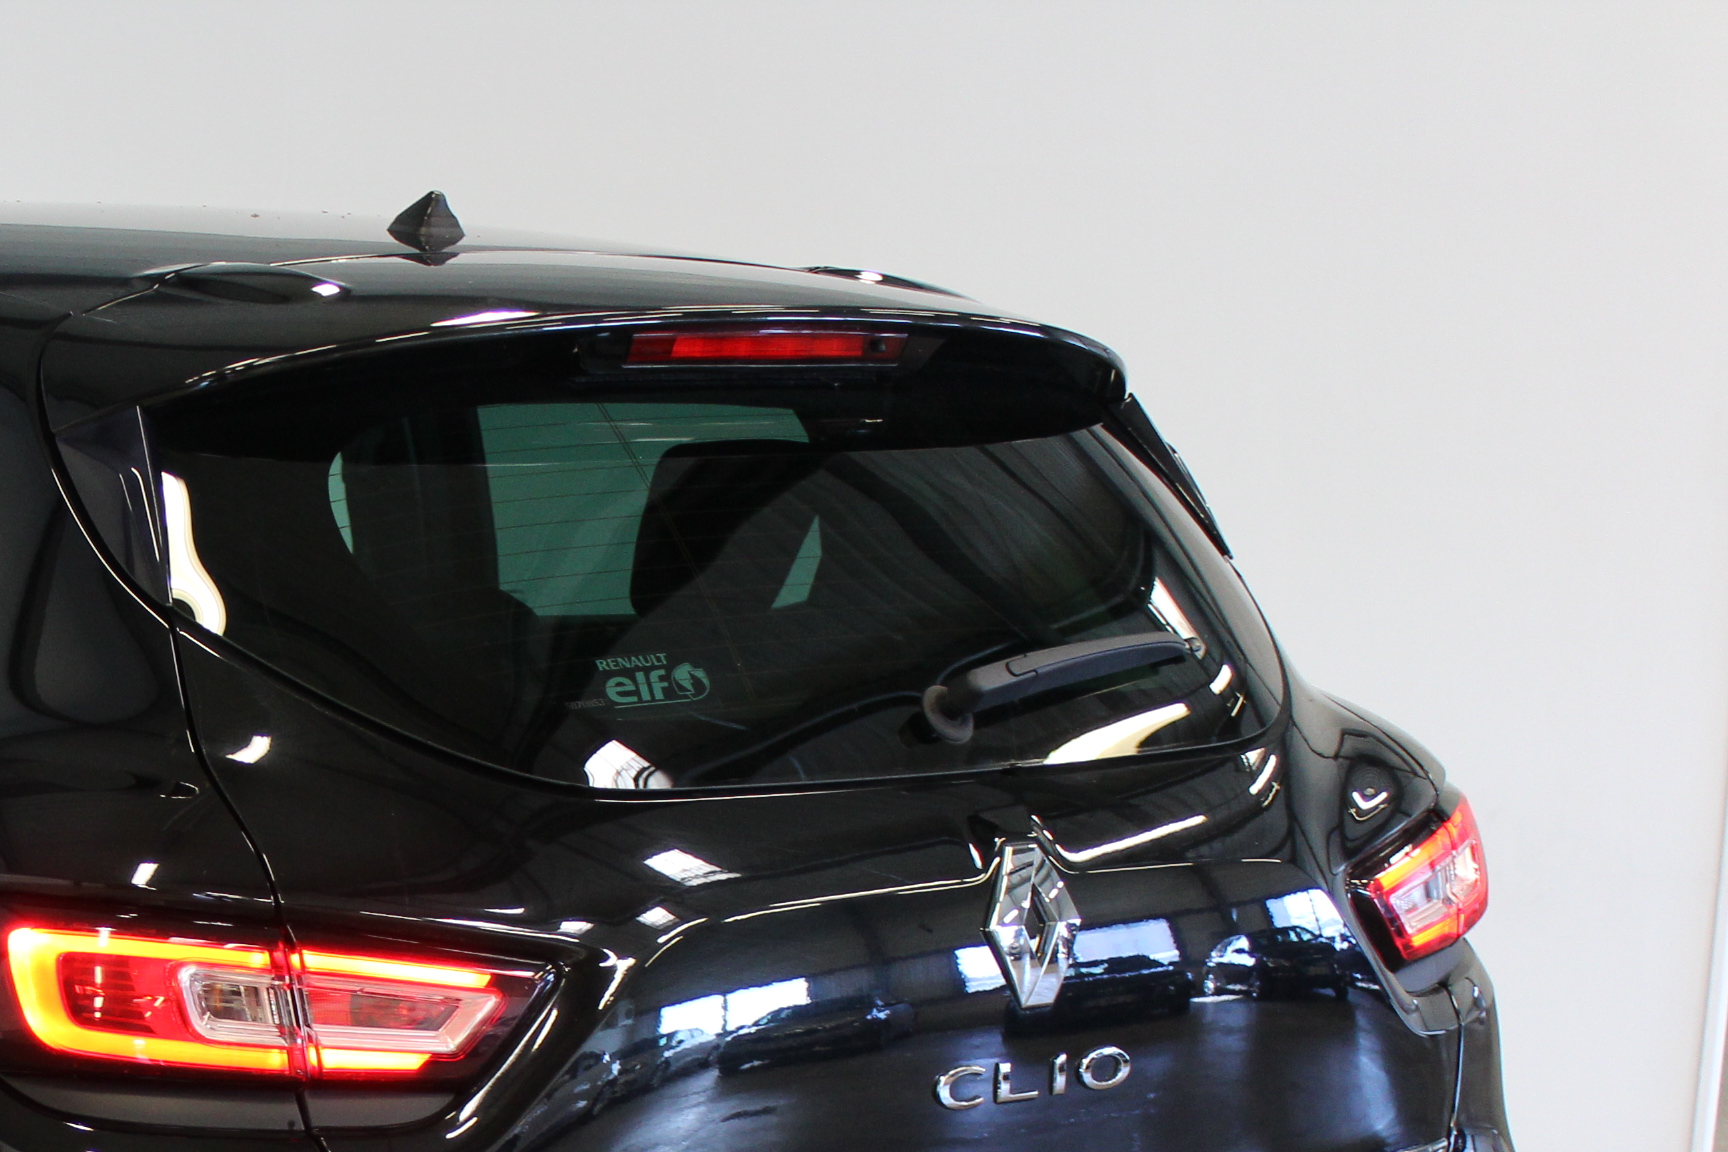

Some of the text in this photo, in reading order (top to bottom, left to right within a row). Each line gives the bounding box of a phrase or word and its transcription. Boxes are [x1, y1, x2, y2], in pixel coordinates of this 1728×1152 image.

[595, 653, 667, 671] RENAULT
[605, 669, 668, 703] elf
[935, 1046, 1131, 1110] CLIO
